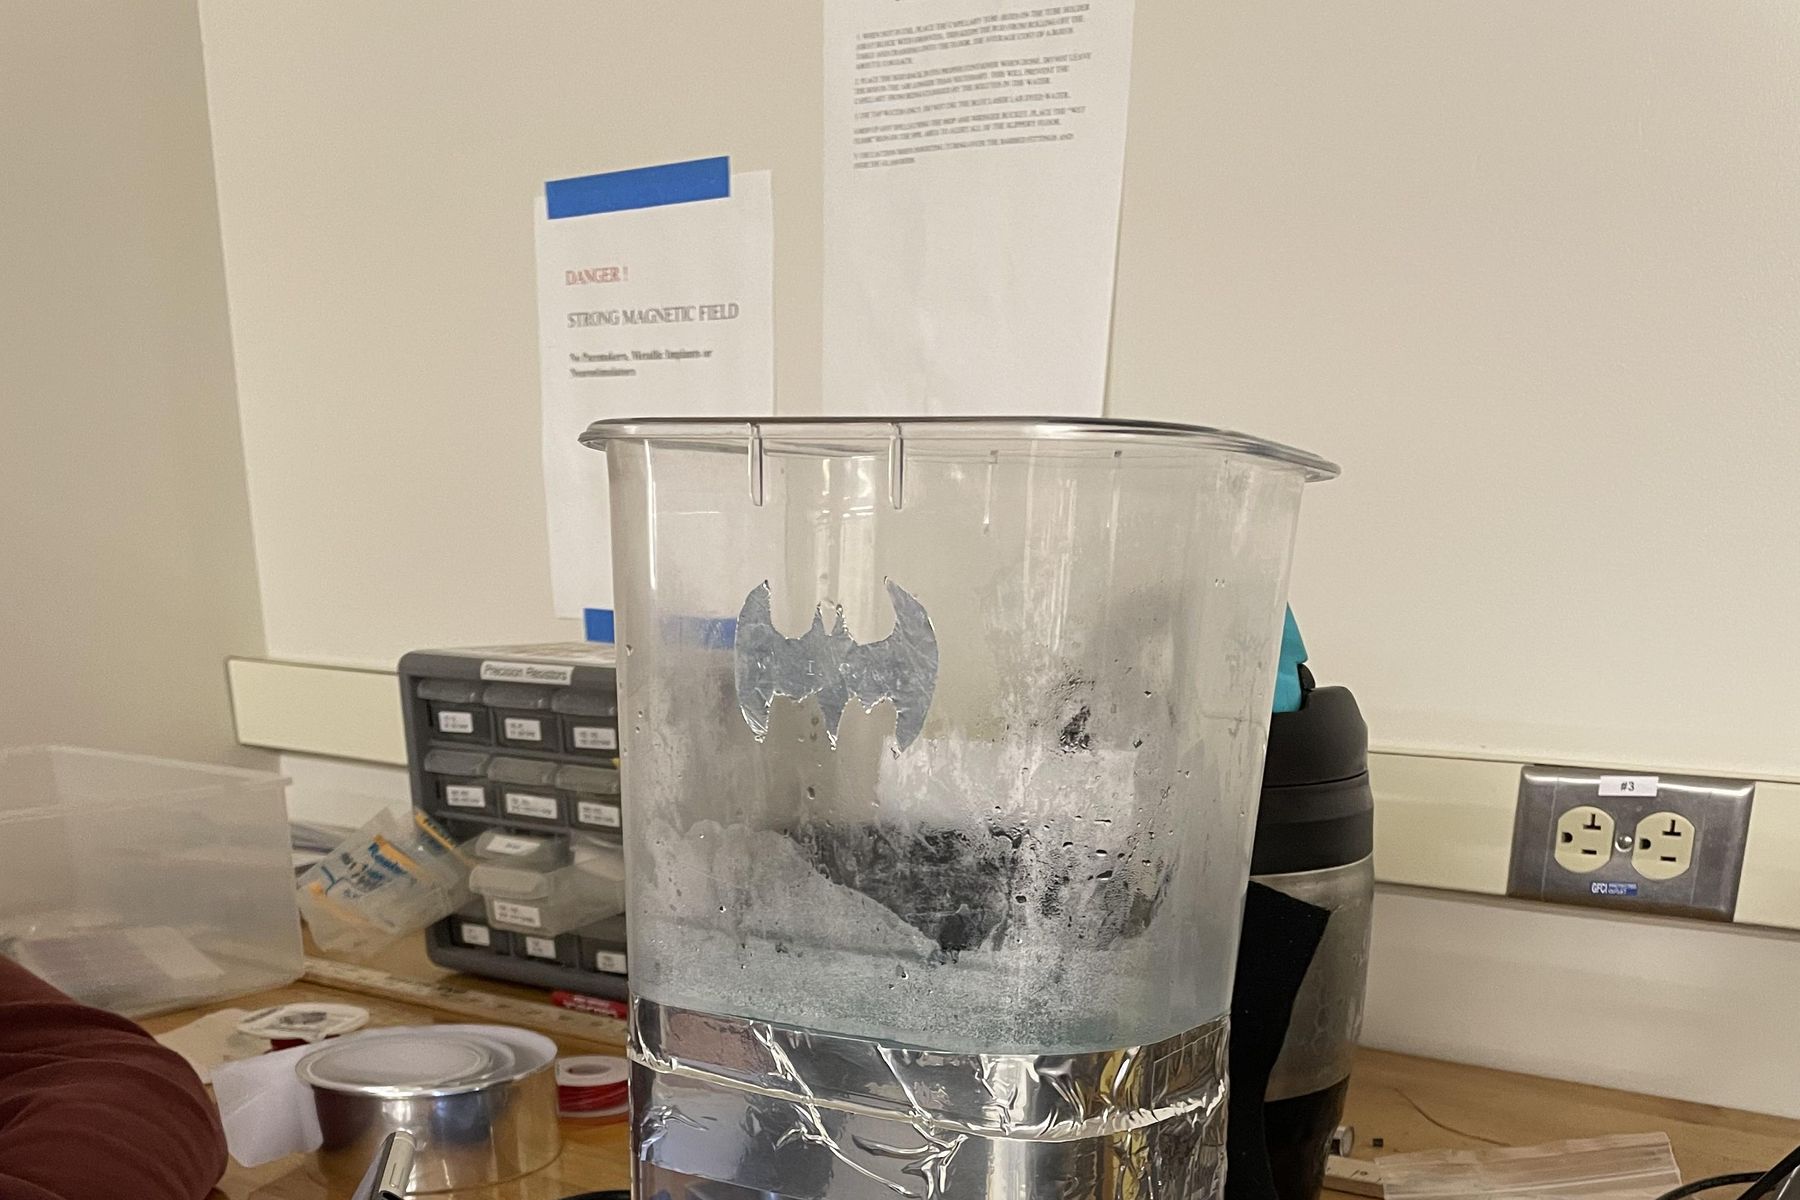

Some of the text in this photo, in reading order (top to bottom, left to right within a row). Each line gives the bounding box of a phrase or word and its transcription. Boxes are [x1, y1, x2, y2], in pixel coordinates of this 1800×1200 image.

[565, 267, 620, 285] DANGER
[567, 303, 739, 328] STRONG MAGNETIC FIELD
[1620, 780, 1635, 792] #3
